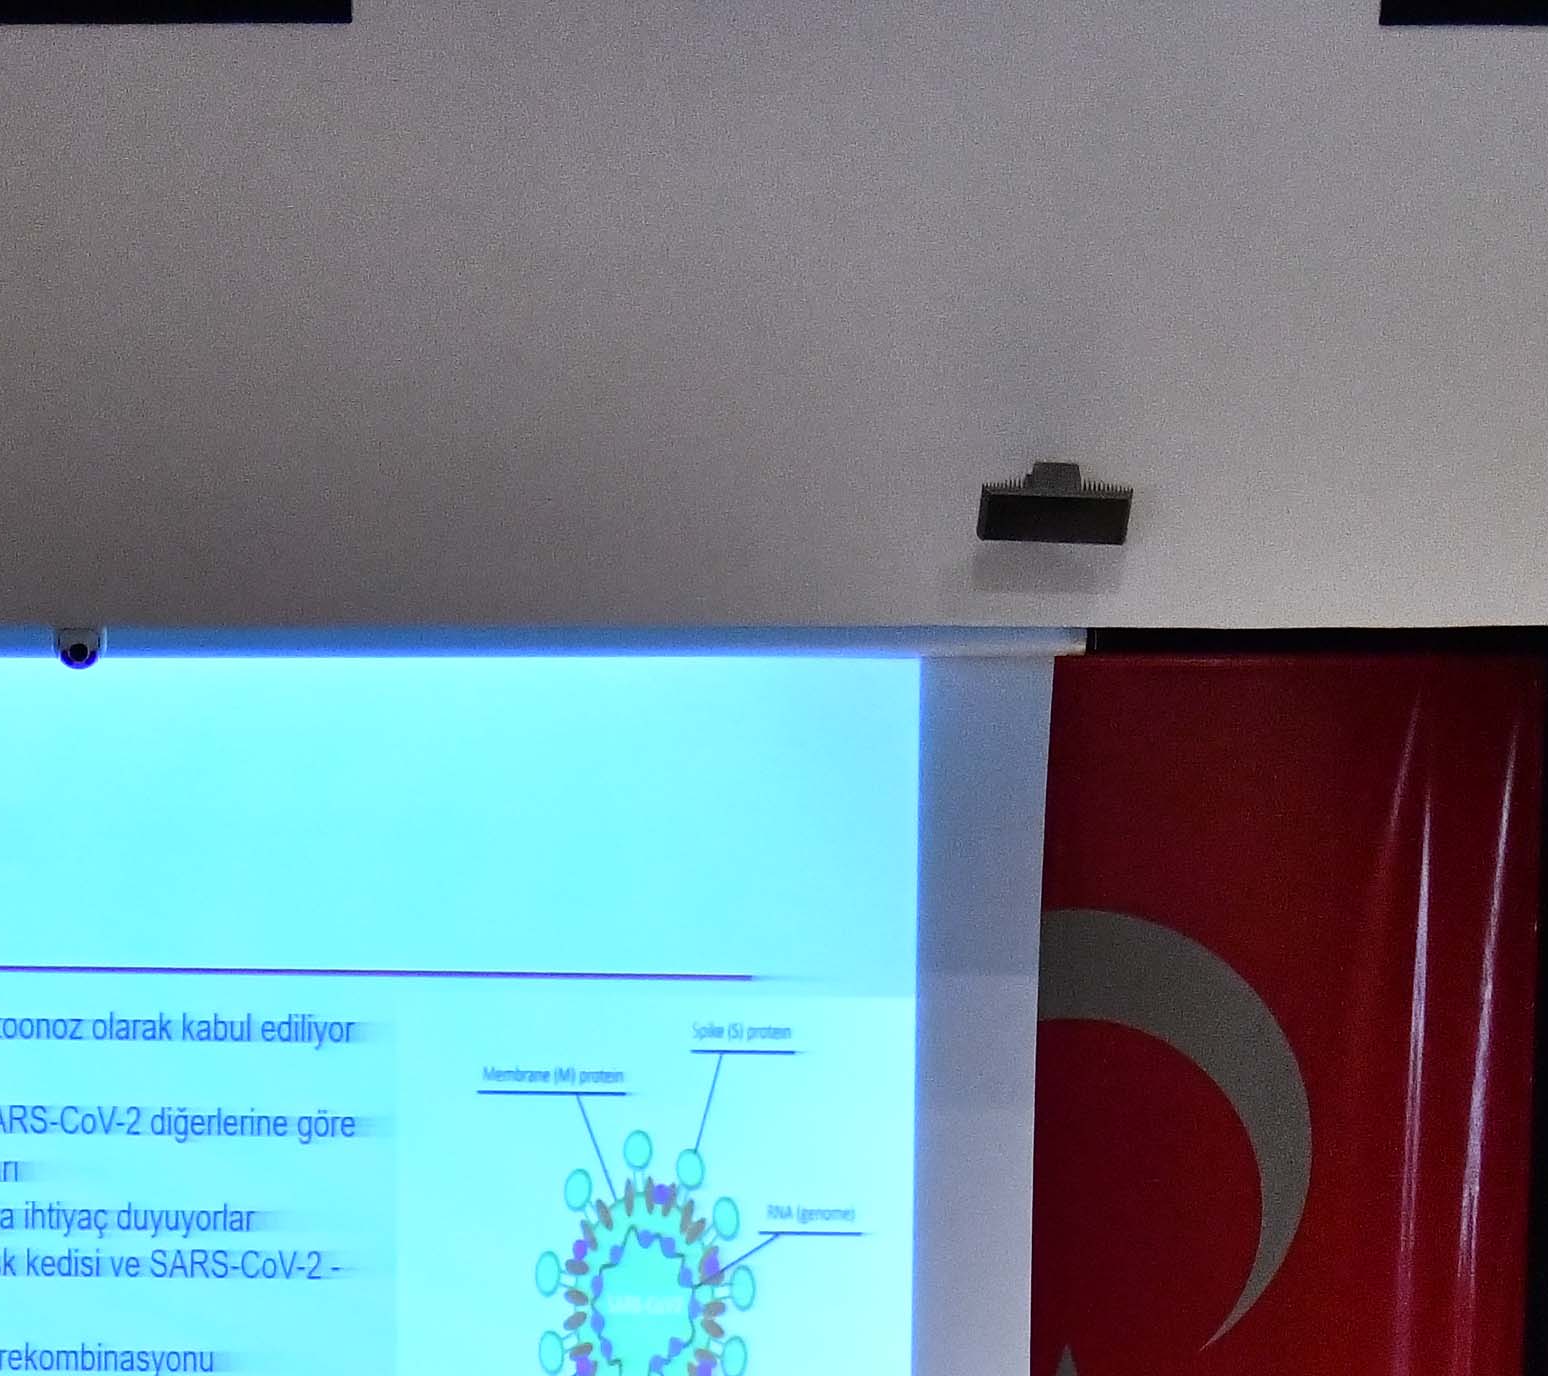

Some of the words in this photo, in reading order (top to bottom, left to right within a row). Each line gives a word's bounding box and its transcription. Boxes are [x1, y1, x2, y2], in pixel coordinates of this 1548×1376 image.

[93, 1010, 172, 1041] olarak
[181, 1011, 251, 1042] kabul
[261, 1013, 354, 1048] ediliyor
[748, 1024, 791, 1040] protein
[483, 1066, 550, 1083] Membrane
[554, 1067, 576, 1085] (M)
[579, 1067, 624, 1084] protein
[150, 1105, 288, 1142] diğerlerine
[297, 1110, 356, 1143] göre
[25, 1198, 108, 1238] ihtiyaç
[117, 1201, 255, 1238] duyuyorlar
[25, 1246, 101, 1276] kedisi
[110, 1253, 141, 1277] ve
[150, 1248, 322, 1278] SARS-CoV-2
